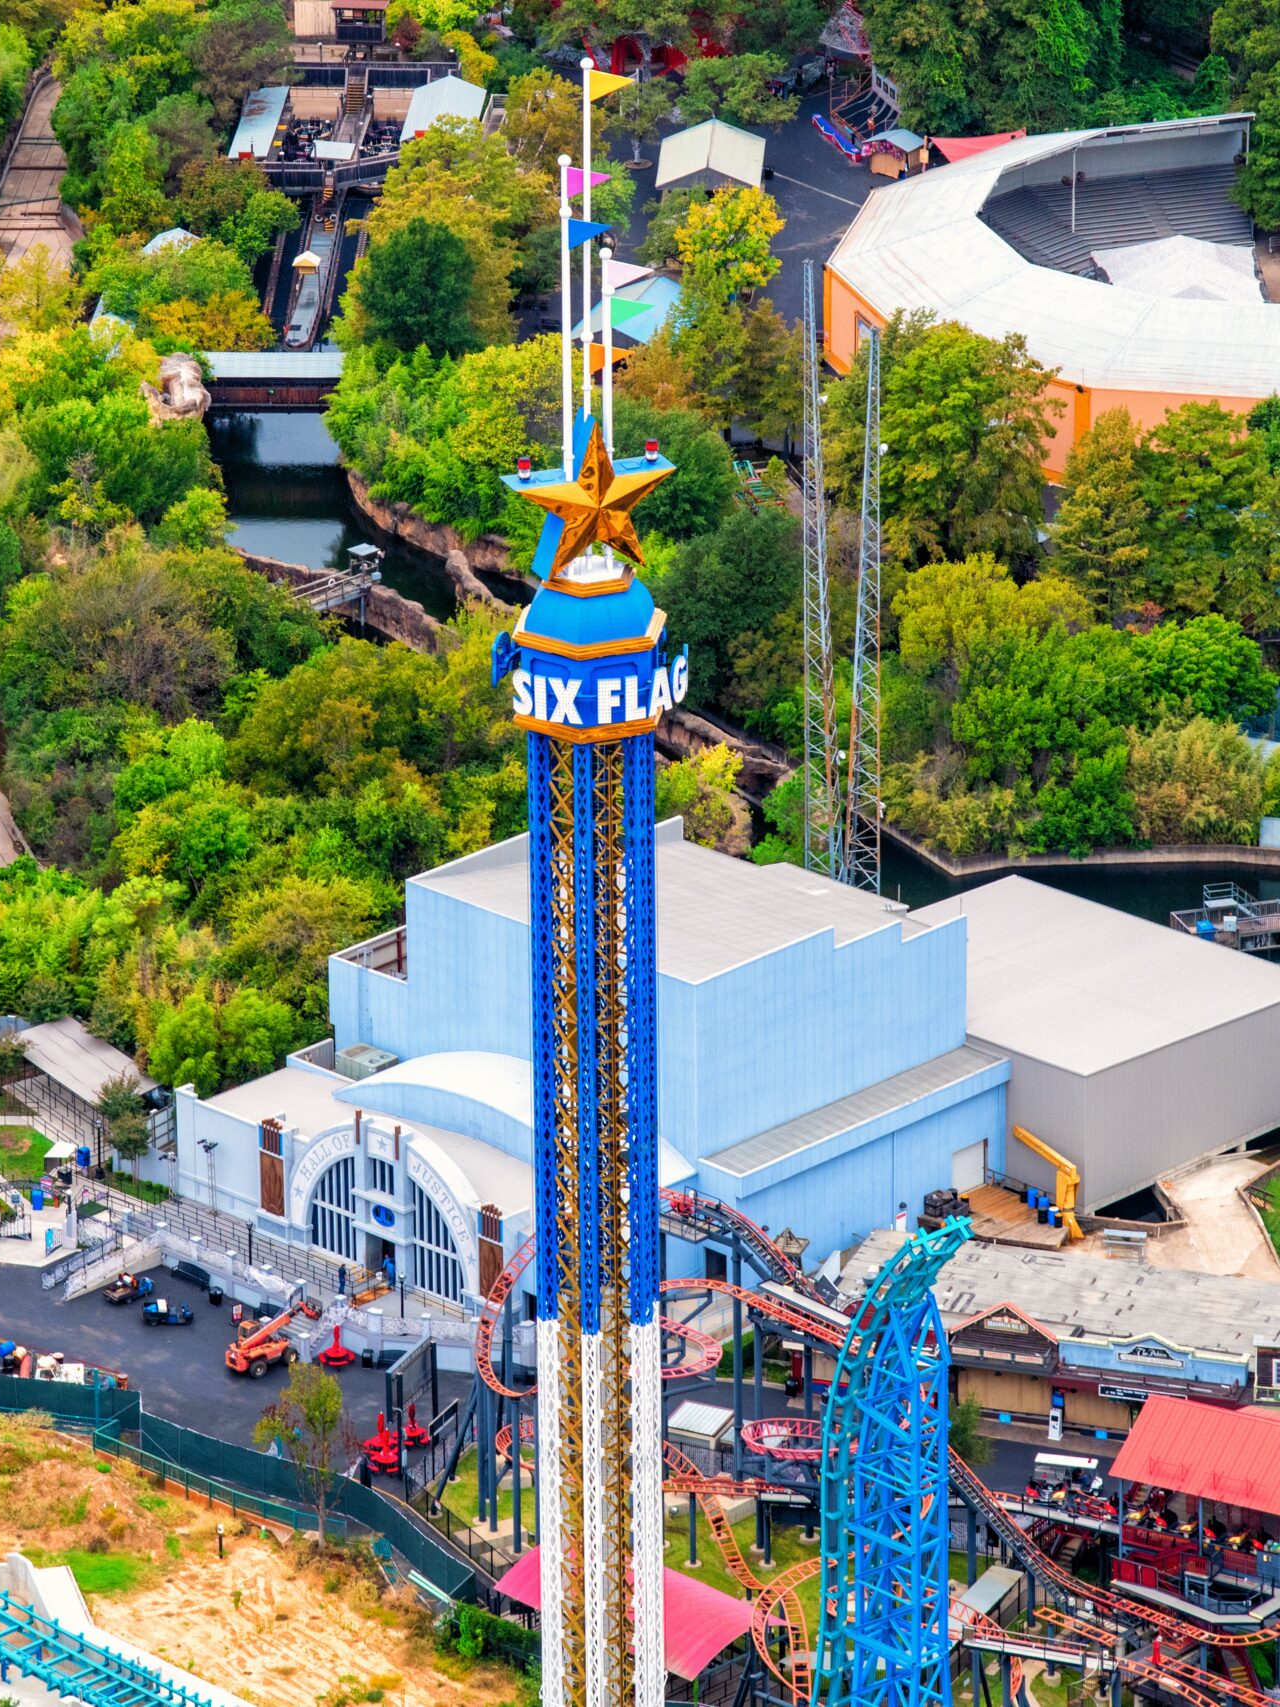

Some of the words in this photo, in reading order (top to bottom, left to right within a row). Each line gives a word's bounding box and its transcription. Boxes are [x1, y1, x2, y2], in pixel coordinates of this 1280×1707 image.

[512, 668, 583, 725] SIX
[597, 646, 689, 725] FLAG
[300, 1144, 332, 1181] HALL
[333, 1133, 352, 1150] OF
[413, 1161, 470, 1242] JUSTICE
